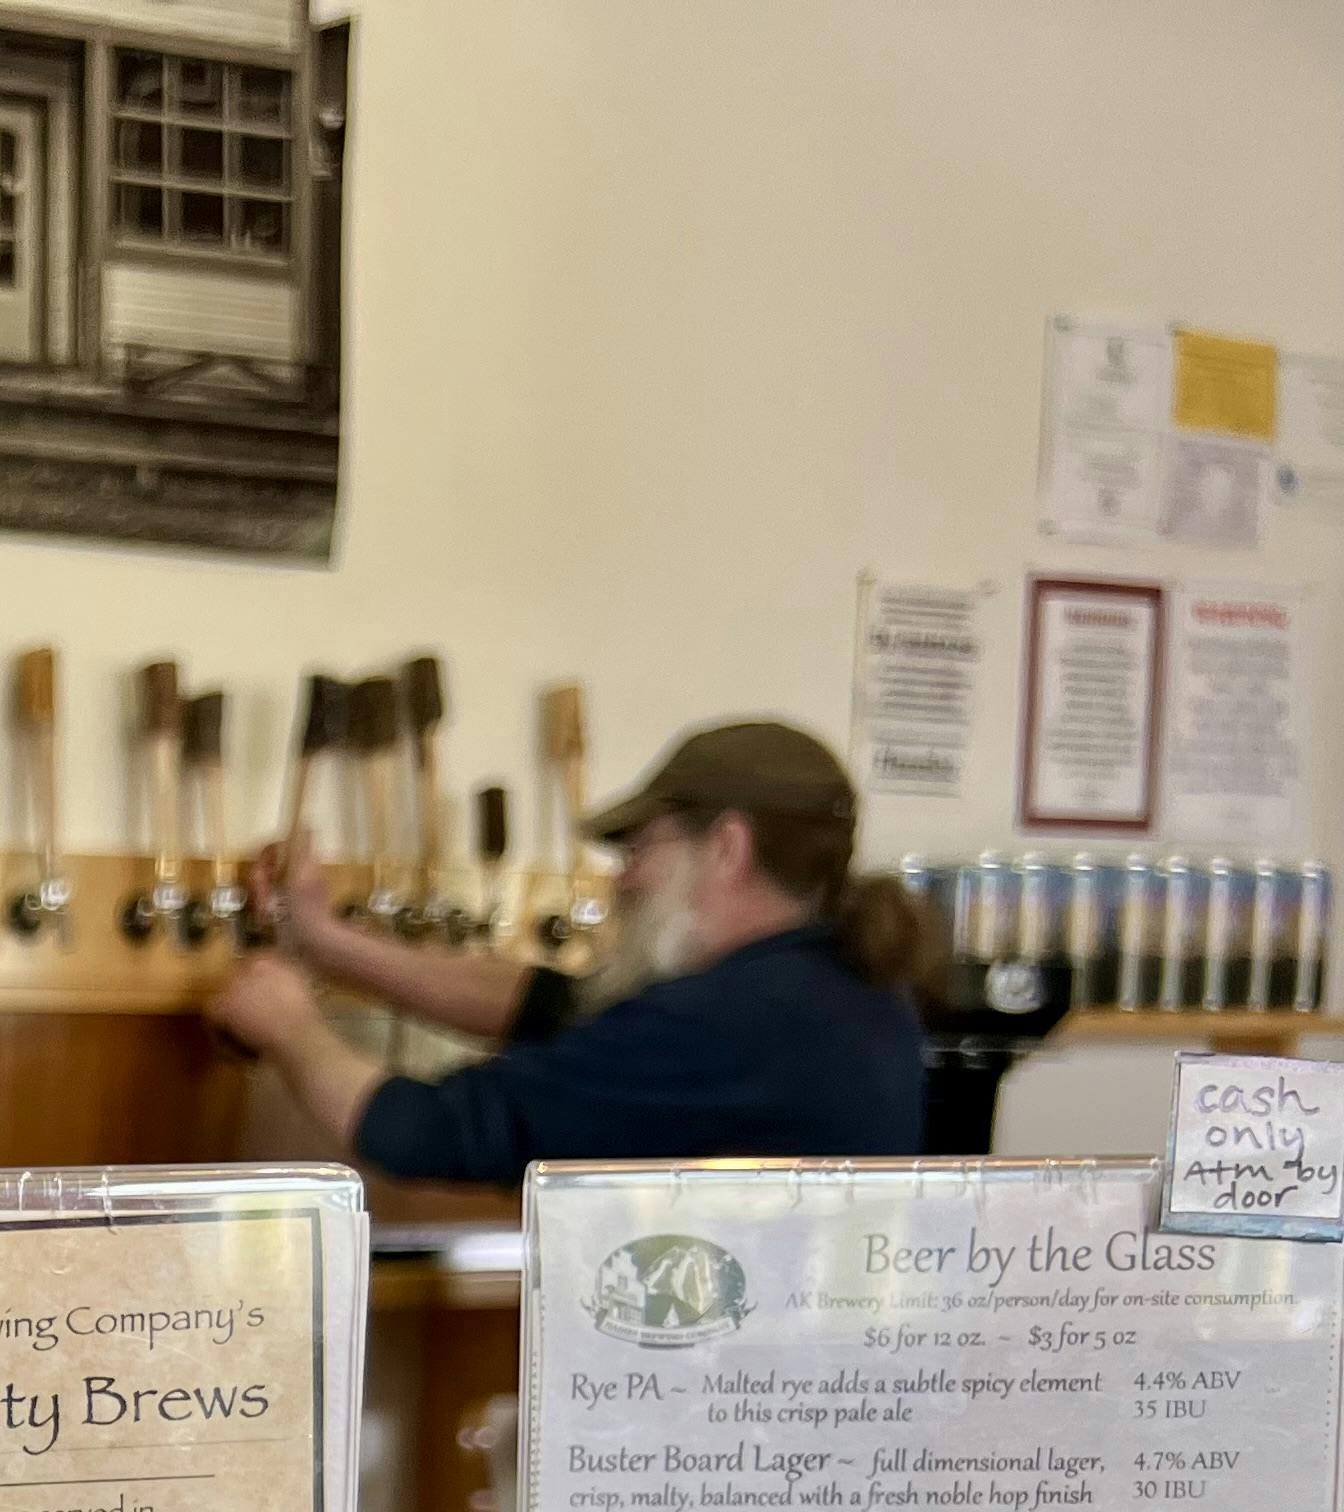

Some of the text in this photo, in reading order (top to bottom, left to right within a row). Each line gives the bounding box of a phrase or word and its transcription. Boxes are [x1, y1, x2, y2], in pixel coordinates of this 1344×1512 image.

[1196, 1076, 1320, 1116] cash
[1206, 1121, 1305, 1166] only
[1213, 1181, 1299, 1211] door
[863, 1225, 1216, 1289] Beer by the Glass
[65, 1299, 265, 1351] Company's
[864, 1324, 987, 1355] $6 for 12 oz.
[1028, 1322, 1138, 1354] $3 for 5 oz
[81, 1376, 269, 1426] Brews
[571, 1369, 1103, 1410] Rye PA Malted rye adds a subtle spicy element
[1133, 1370, 1242, 1392] 4.4% ABV
[1134, 1399, 1206, 1419] 35 IBU
[569, 1443, 832, 1483] Buster Board Lager
